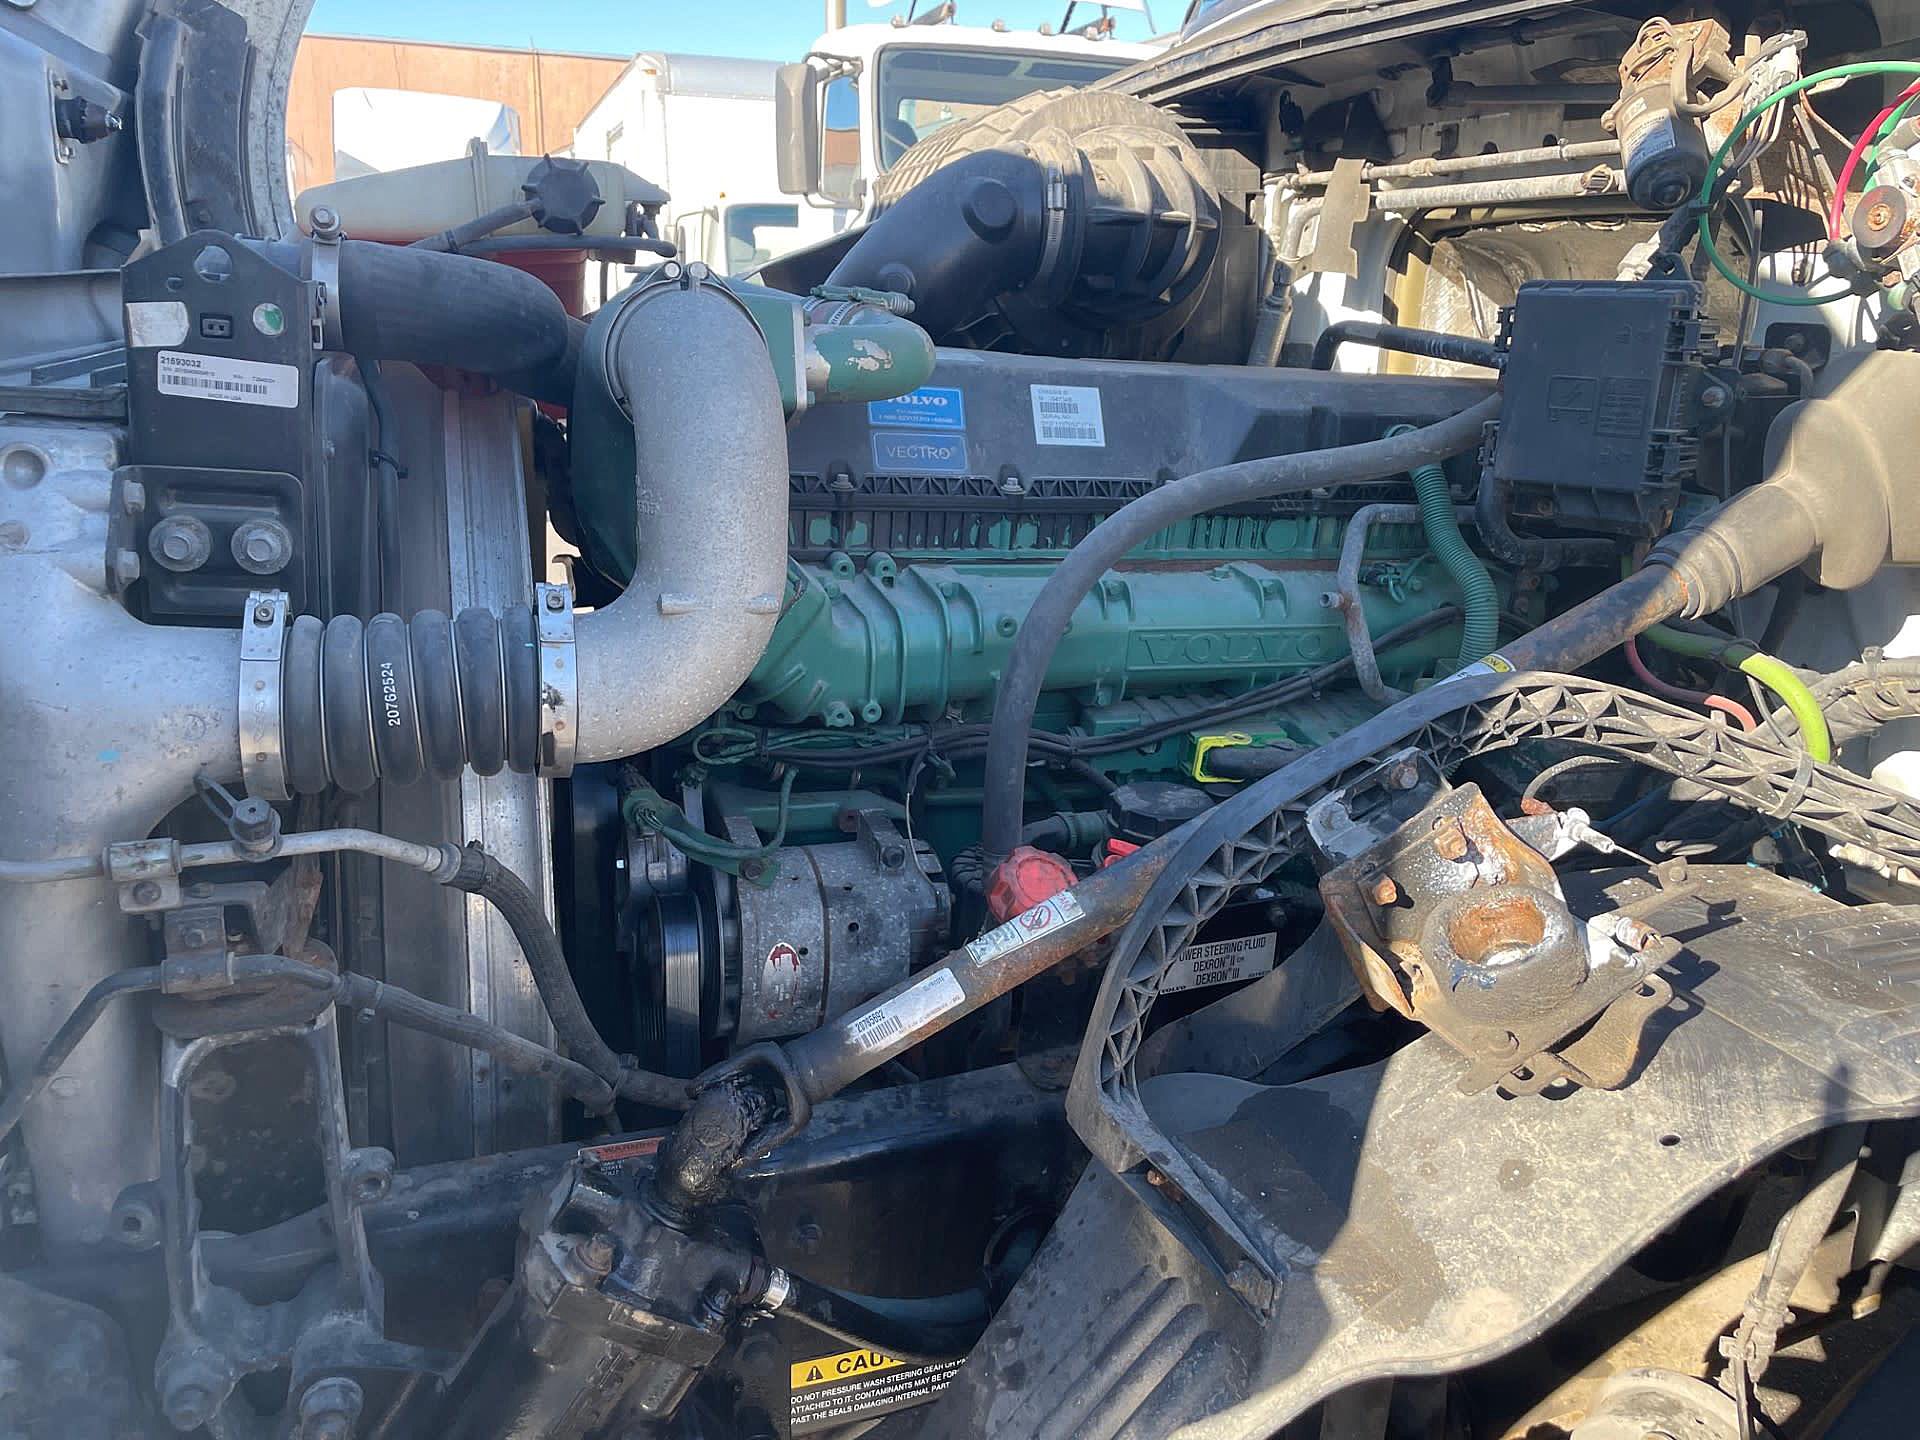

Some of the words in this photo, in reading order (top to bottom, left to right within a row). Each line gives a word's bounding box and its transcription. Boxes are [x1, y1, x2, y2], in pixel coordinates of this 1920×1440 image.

[1139, 631, 1326, 664] VOLVO
[380, 662, 401, 727] 20762524
[1179, 947, 1203, 962] OWER
[1204, 941, 1243, 957] STEERING
[1244, 936, 1266, 950] FLUID
[836, 1351, 894, 1374] CAU
[791, 1396, 803, 1405] DO
[804, 1391, 821, 1402] NOT
[821, 1382, 862, 1398] PRESSURE
[863, 1377, 885, 1389] WASH
[886, 1367, 923, 1384] STEERING
[791, 1400, 831, 1415] ATTACHED
[832, 1398, 843, 1406] TO
[855, 1381, 913, 1401] CONTAMINANTS
[914, 1376, 930, 1387] MAY
[931, 1373, 942, 1382] BE
[943, 1368, 960, 1380] FOR
[791, 1414, 812, 1425] PAST
[812, 1410, 828, 1420] THE
[828, 1405, 852, 1417] SEALS
[853, 1396, 894, 1412] DAMAGING
[895, 1387, 930, 1402] INTERNAL
